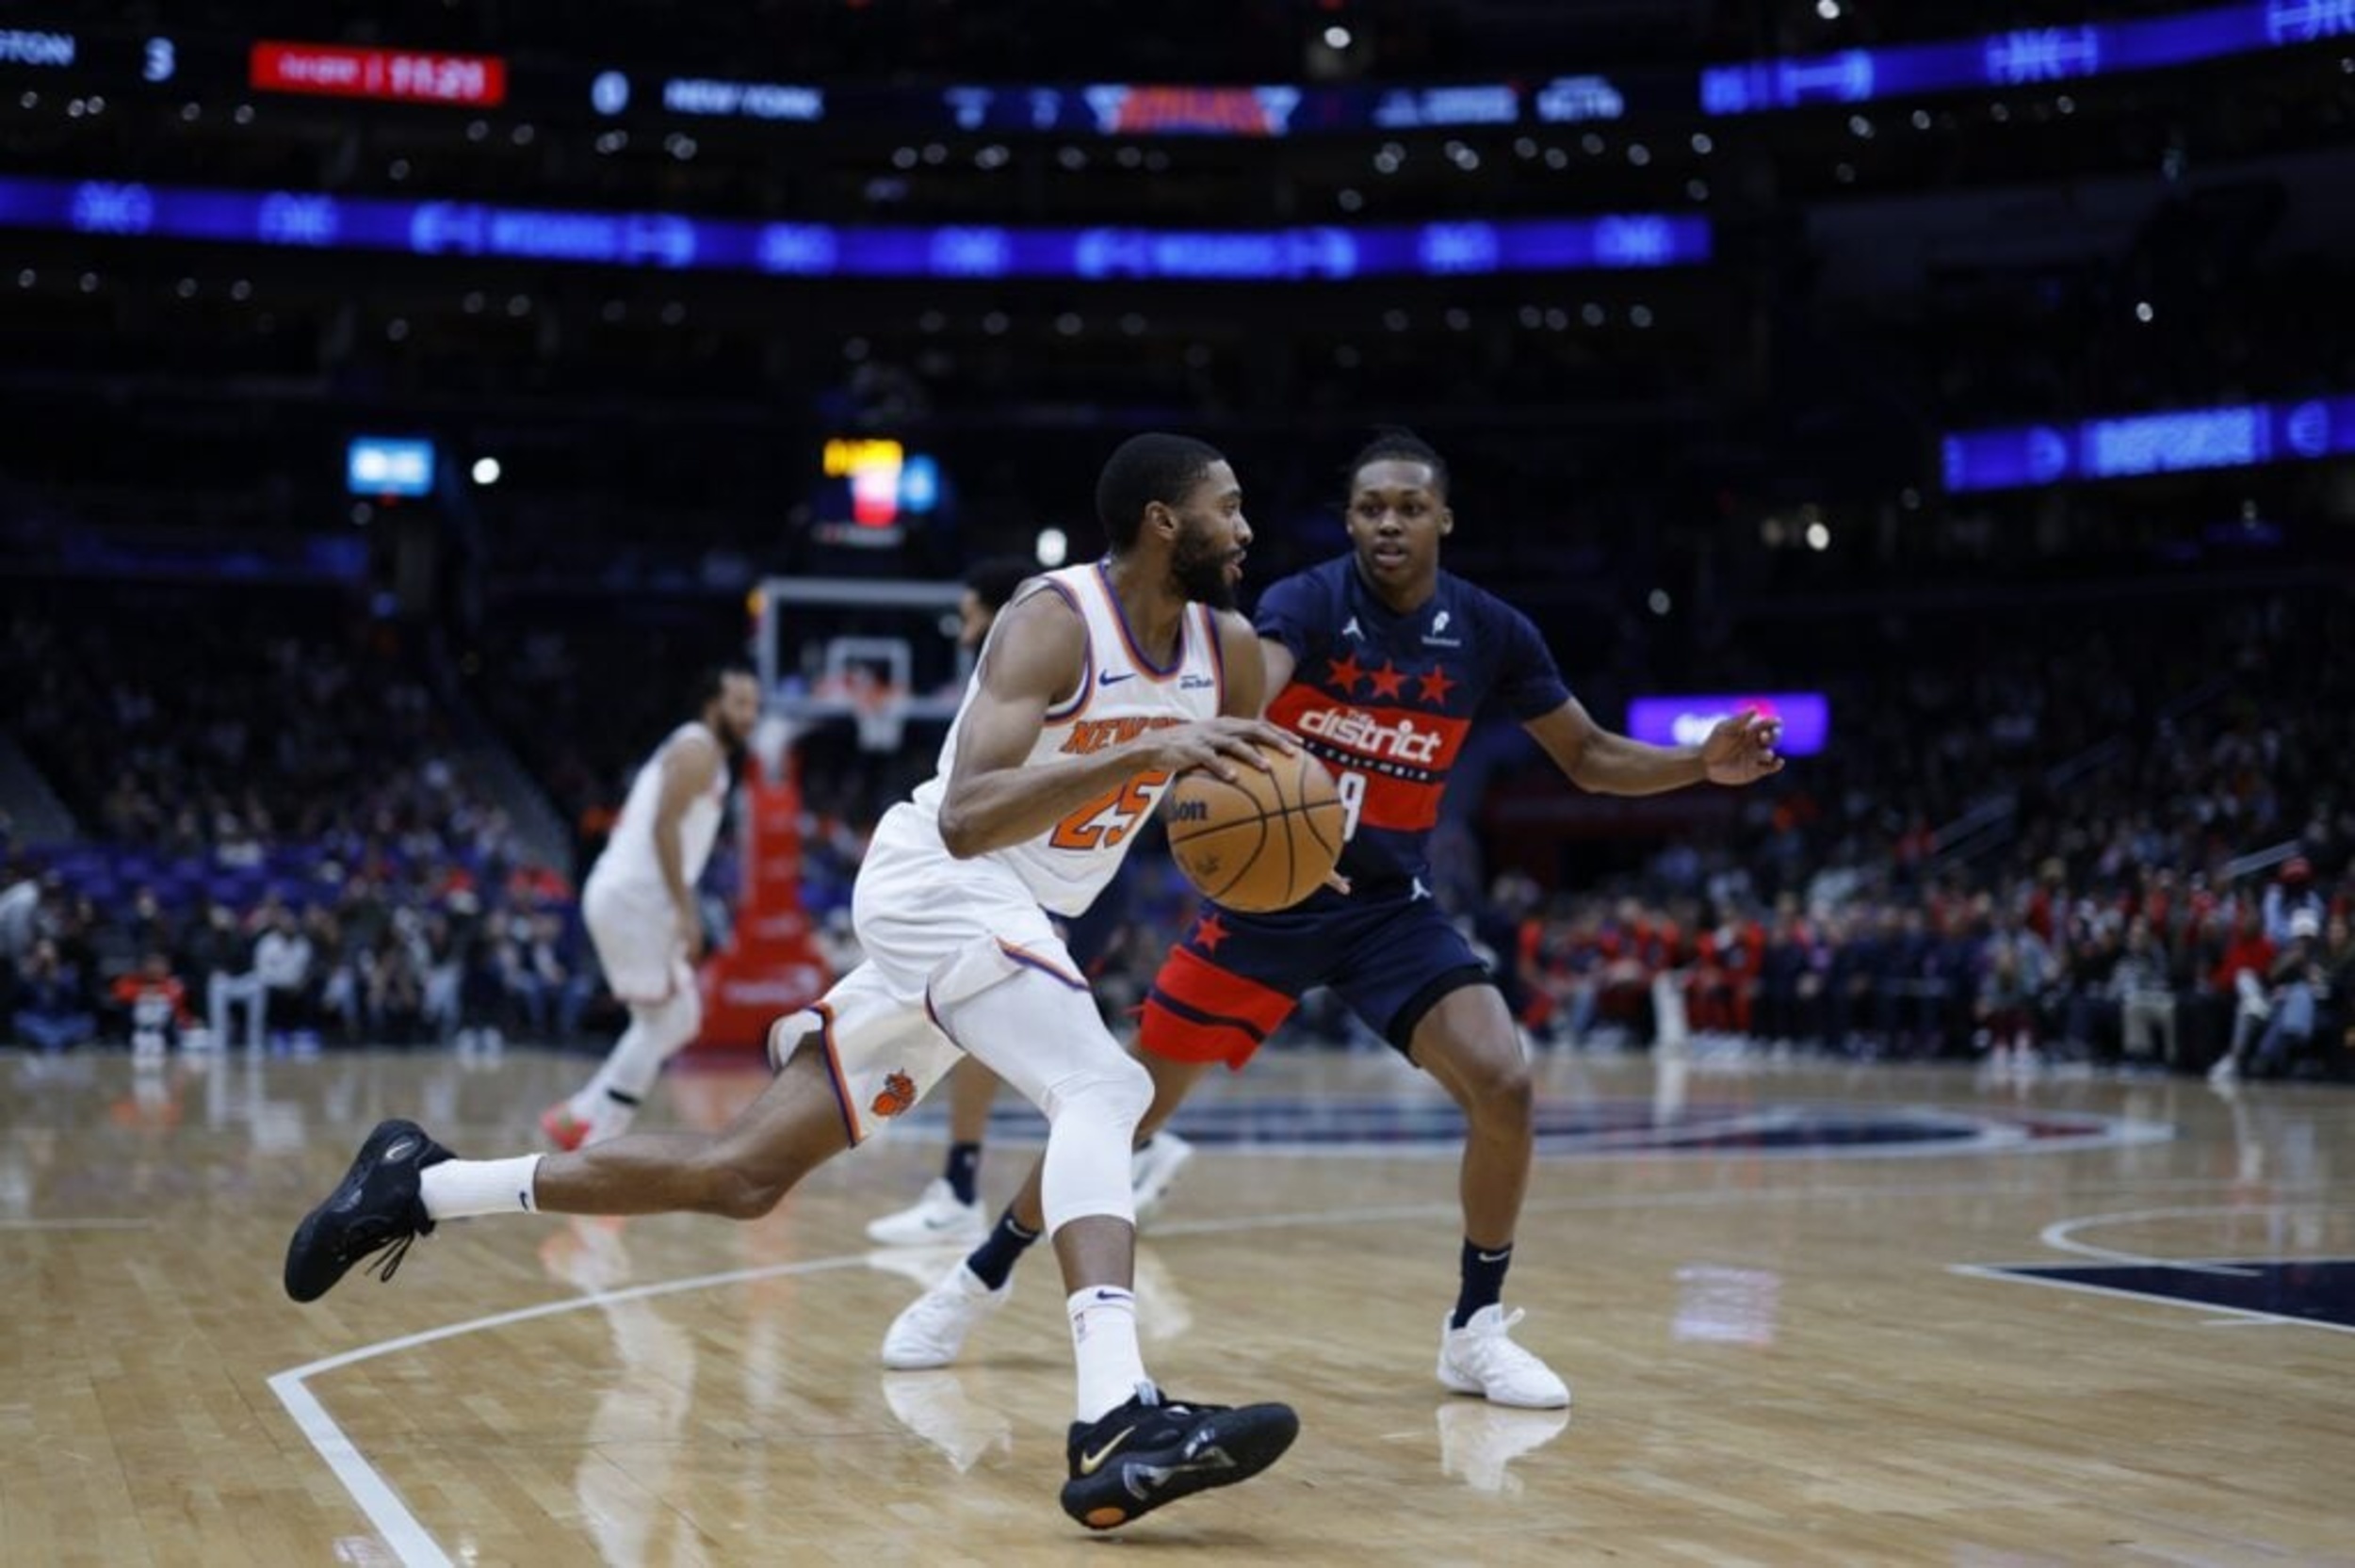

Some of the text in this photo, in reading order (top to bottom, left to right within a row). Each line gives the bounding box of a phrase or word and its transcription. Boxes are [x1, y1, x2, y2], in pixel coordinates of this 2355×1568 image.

[144, 37, 175, 81] 3
[1298, 710, 1442, 764] district
[1048, 770, 1170, 849] 25
